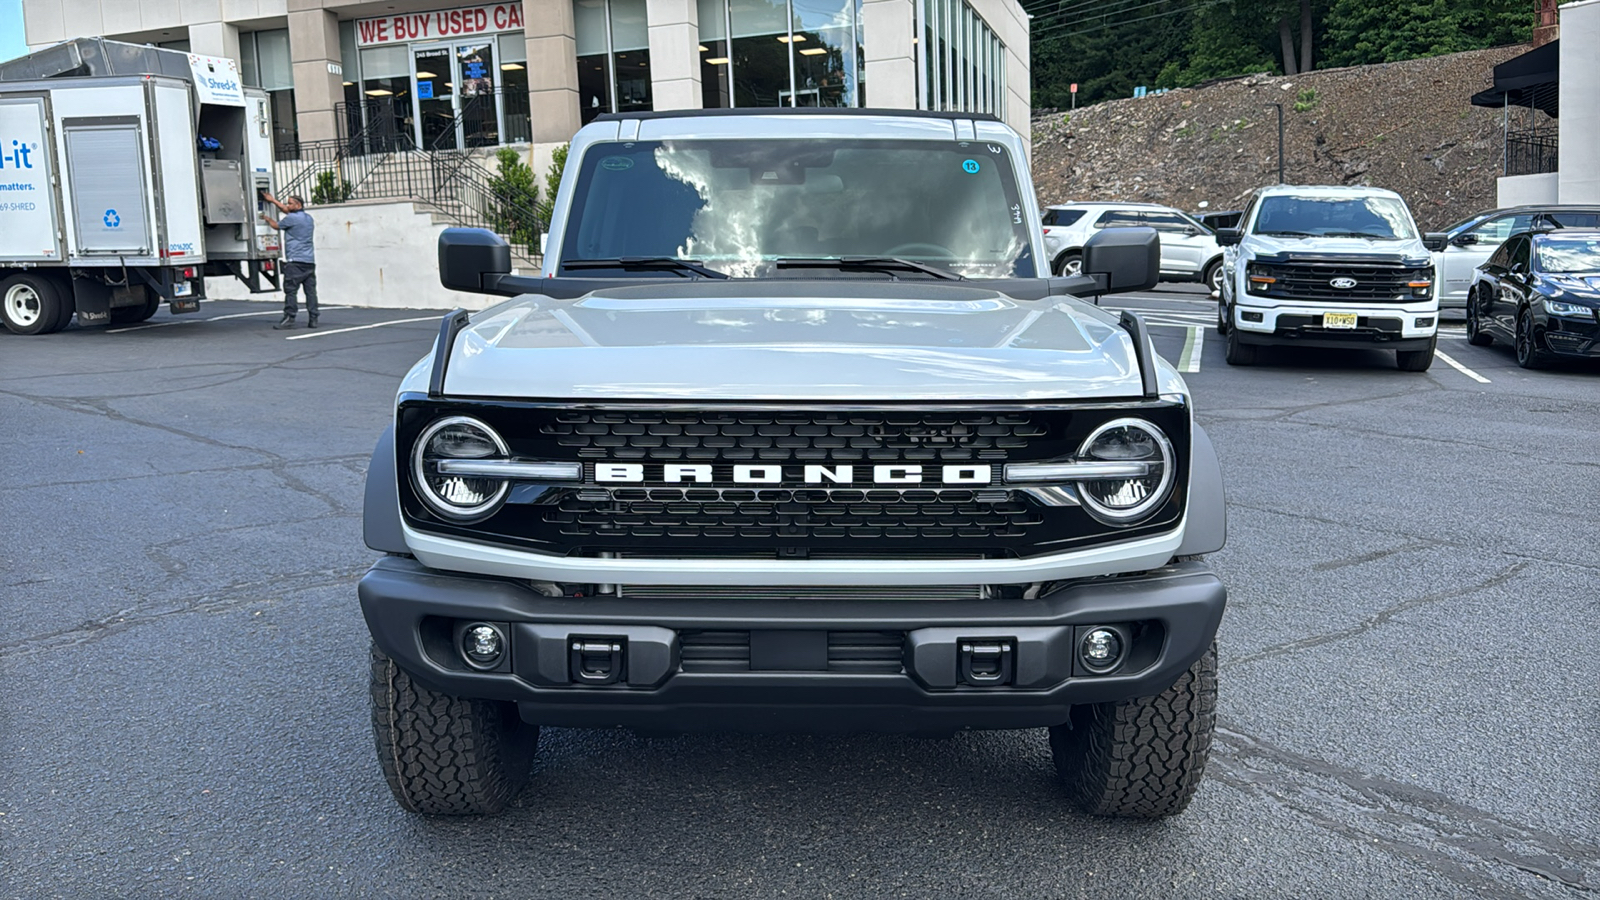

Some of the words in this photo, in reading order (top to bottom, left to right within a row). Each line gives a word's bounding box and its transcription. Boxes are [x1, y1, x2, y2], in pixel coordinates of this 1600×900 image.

[359, 19, 389, 43] WE
[394, 14, 431, 40] BUY
[436, 8, 488, 36] USED
[208, 78, 238, 91] Shred-it
[965, 163, 977, 171] 13
[0, 182, 35, 191] matters.
[594, 463, 992, 484] BRONCO
